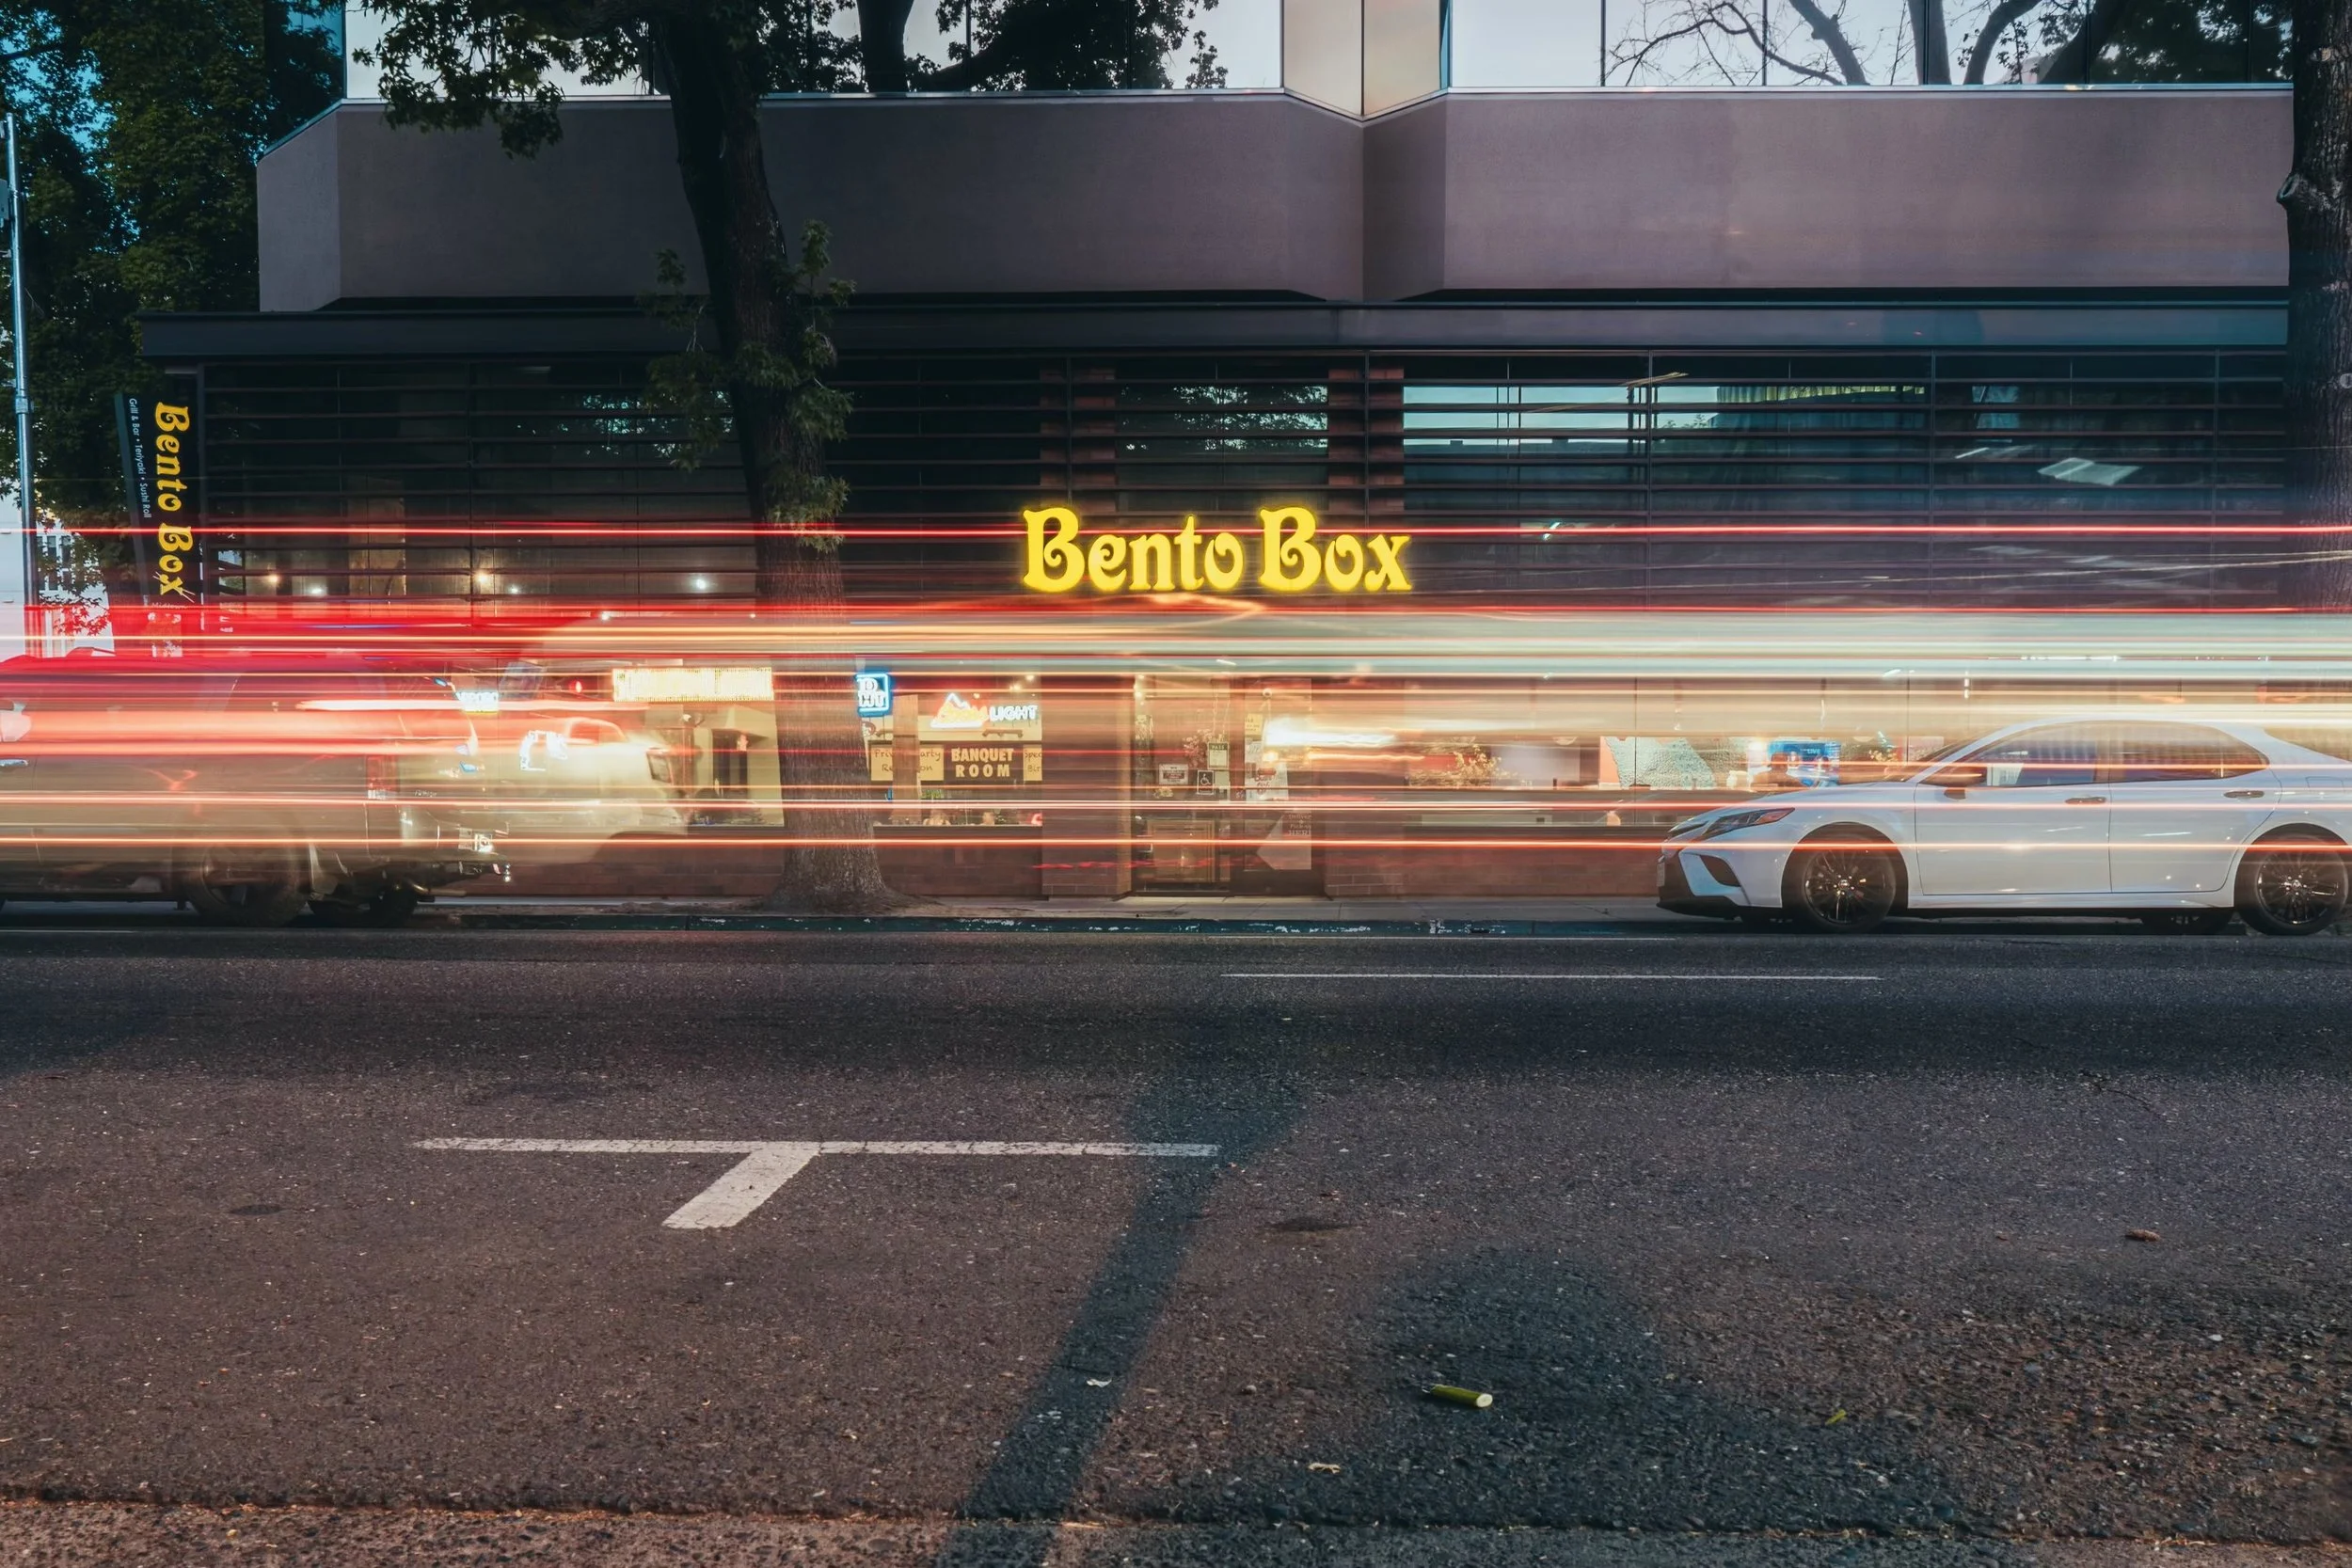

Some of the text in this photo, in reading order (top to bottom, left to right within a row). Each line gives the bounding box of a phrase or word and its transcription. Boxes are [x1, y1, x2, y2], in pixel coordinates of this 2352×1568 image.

[129, 398, 138, 414] Grill
[135, 444, 146, 475] Teriyaki
[155, 402, 190, 512] Bento
[140, 483, 151, 503] Sushi
[143, 503, 151, 518] Roll
[158, 522, 194, 596] Box
[1023, 507, 1412, 593] Bento Box
[989, 705, 1039, 722] LIGHT
[951, 747, 1014, 763] BANQUET
[956, 764, 1010, 778] ROOM
